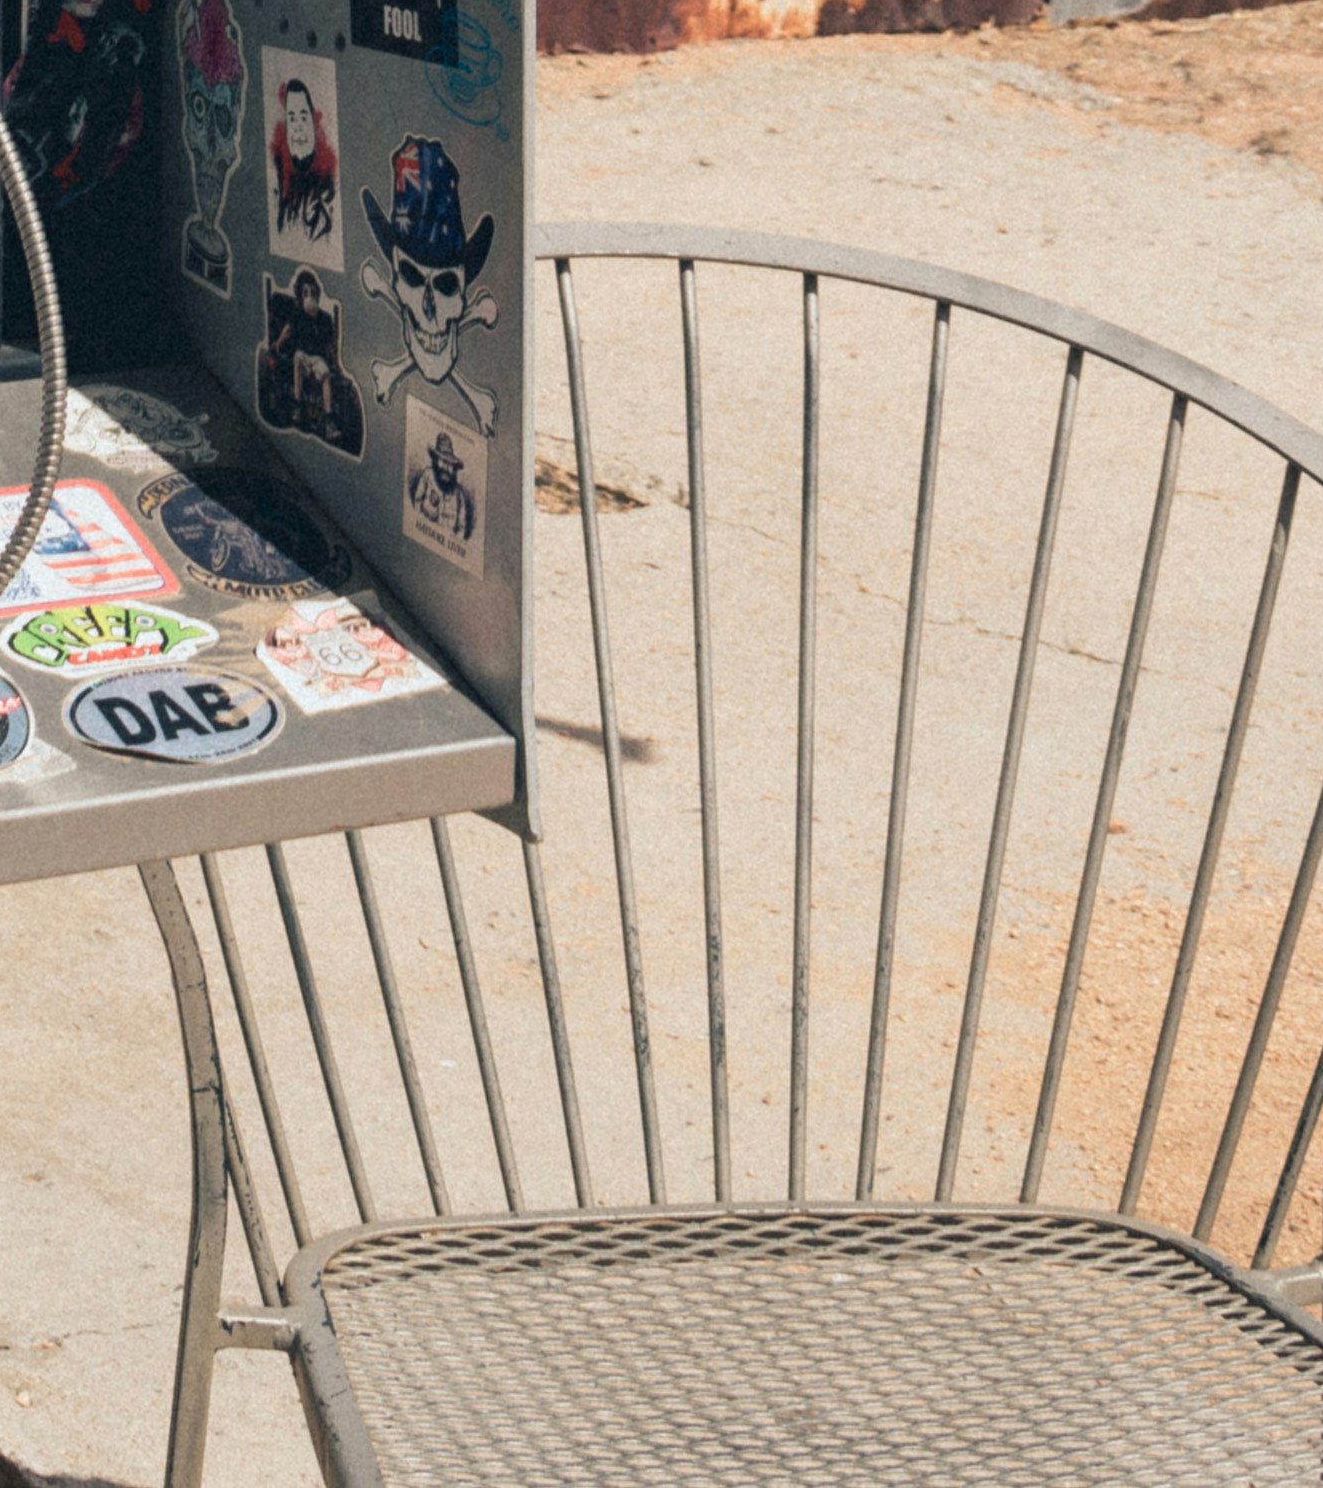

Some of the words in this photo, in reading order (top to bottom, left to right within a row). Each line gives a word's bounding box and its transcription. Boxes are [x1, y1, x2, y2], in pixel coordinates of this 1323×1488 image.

[382, 4, 423, 43] FOOL
[8, 605, 210, 668] CREEPY
[321, 642, 364, 671] 66
[94, 682, 252, 744] DAB
